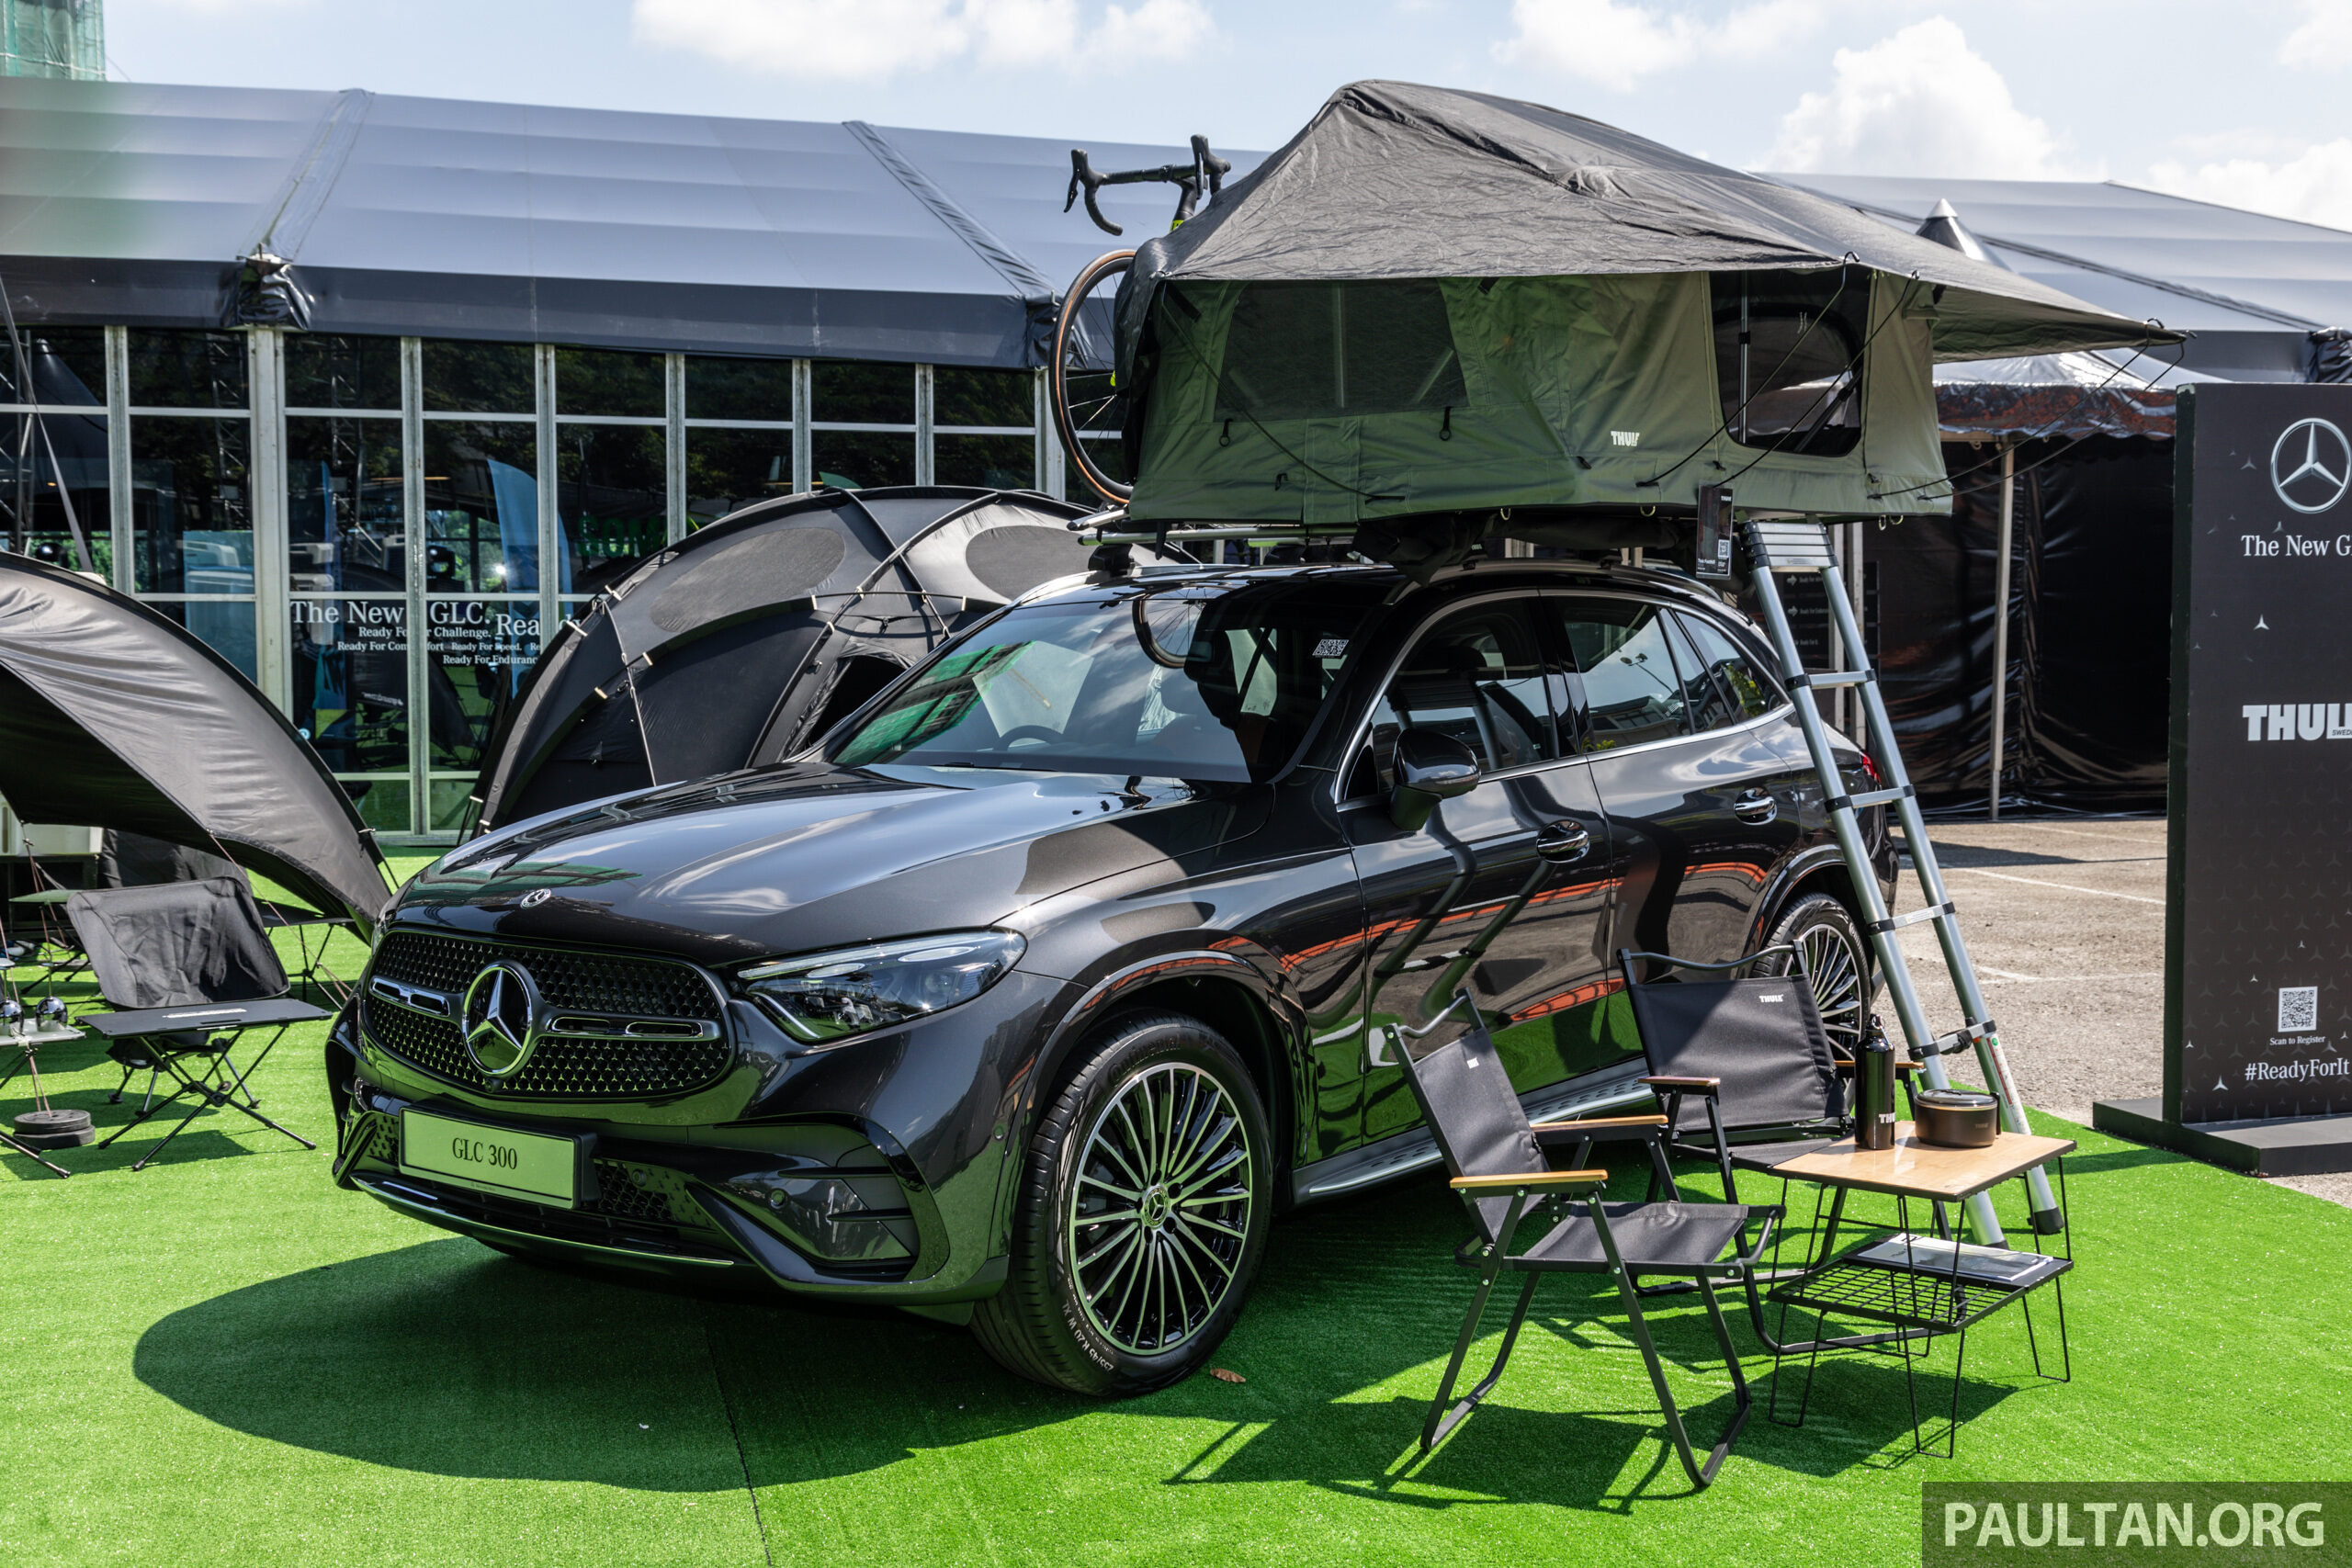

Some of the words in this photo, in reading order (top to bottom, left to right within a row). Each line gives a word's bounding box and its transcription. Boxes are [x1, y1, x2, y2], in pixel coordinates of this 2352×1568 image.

[2241, 535, 2279, 557] The
[2285, 535, 2330, 557] New
[2335, 535, 2352, 557] G
[290, 601, 339, 624] The
[347, 601, 404, 624] New
[429, 602, 492, 625] GLC.
[358, 626, 392, 638] Ready
[434, 627, 492, 639] Challenge.
[337, 641, 368, 652] Ready
[369, 642, 386, 651] For
[452, 642, 477, 652] Ready
[479, 643, 493, 651] For
[443, 656, 472, 665] Ready
[474, 656, 491, 664] For
[492, 655, 538, 665] Enduranc
[1758, 994, 1784, 1002] THULE
[2269, 1037, 2287, 1045] Scan
[2297, 1035, 2326, 1045] Register
[2245, 1057, 2350, 1082] #ReadyForIt
[452, 1137, 484, 1163] GLC
[488, 1145, 518, 1170] 300
